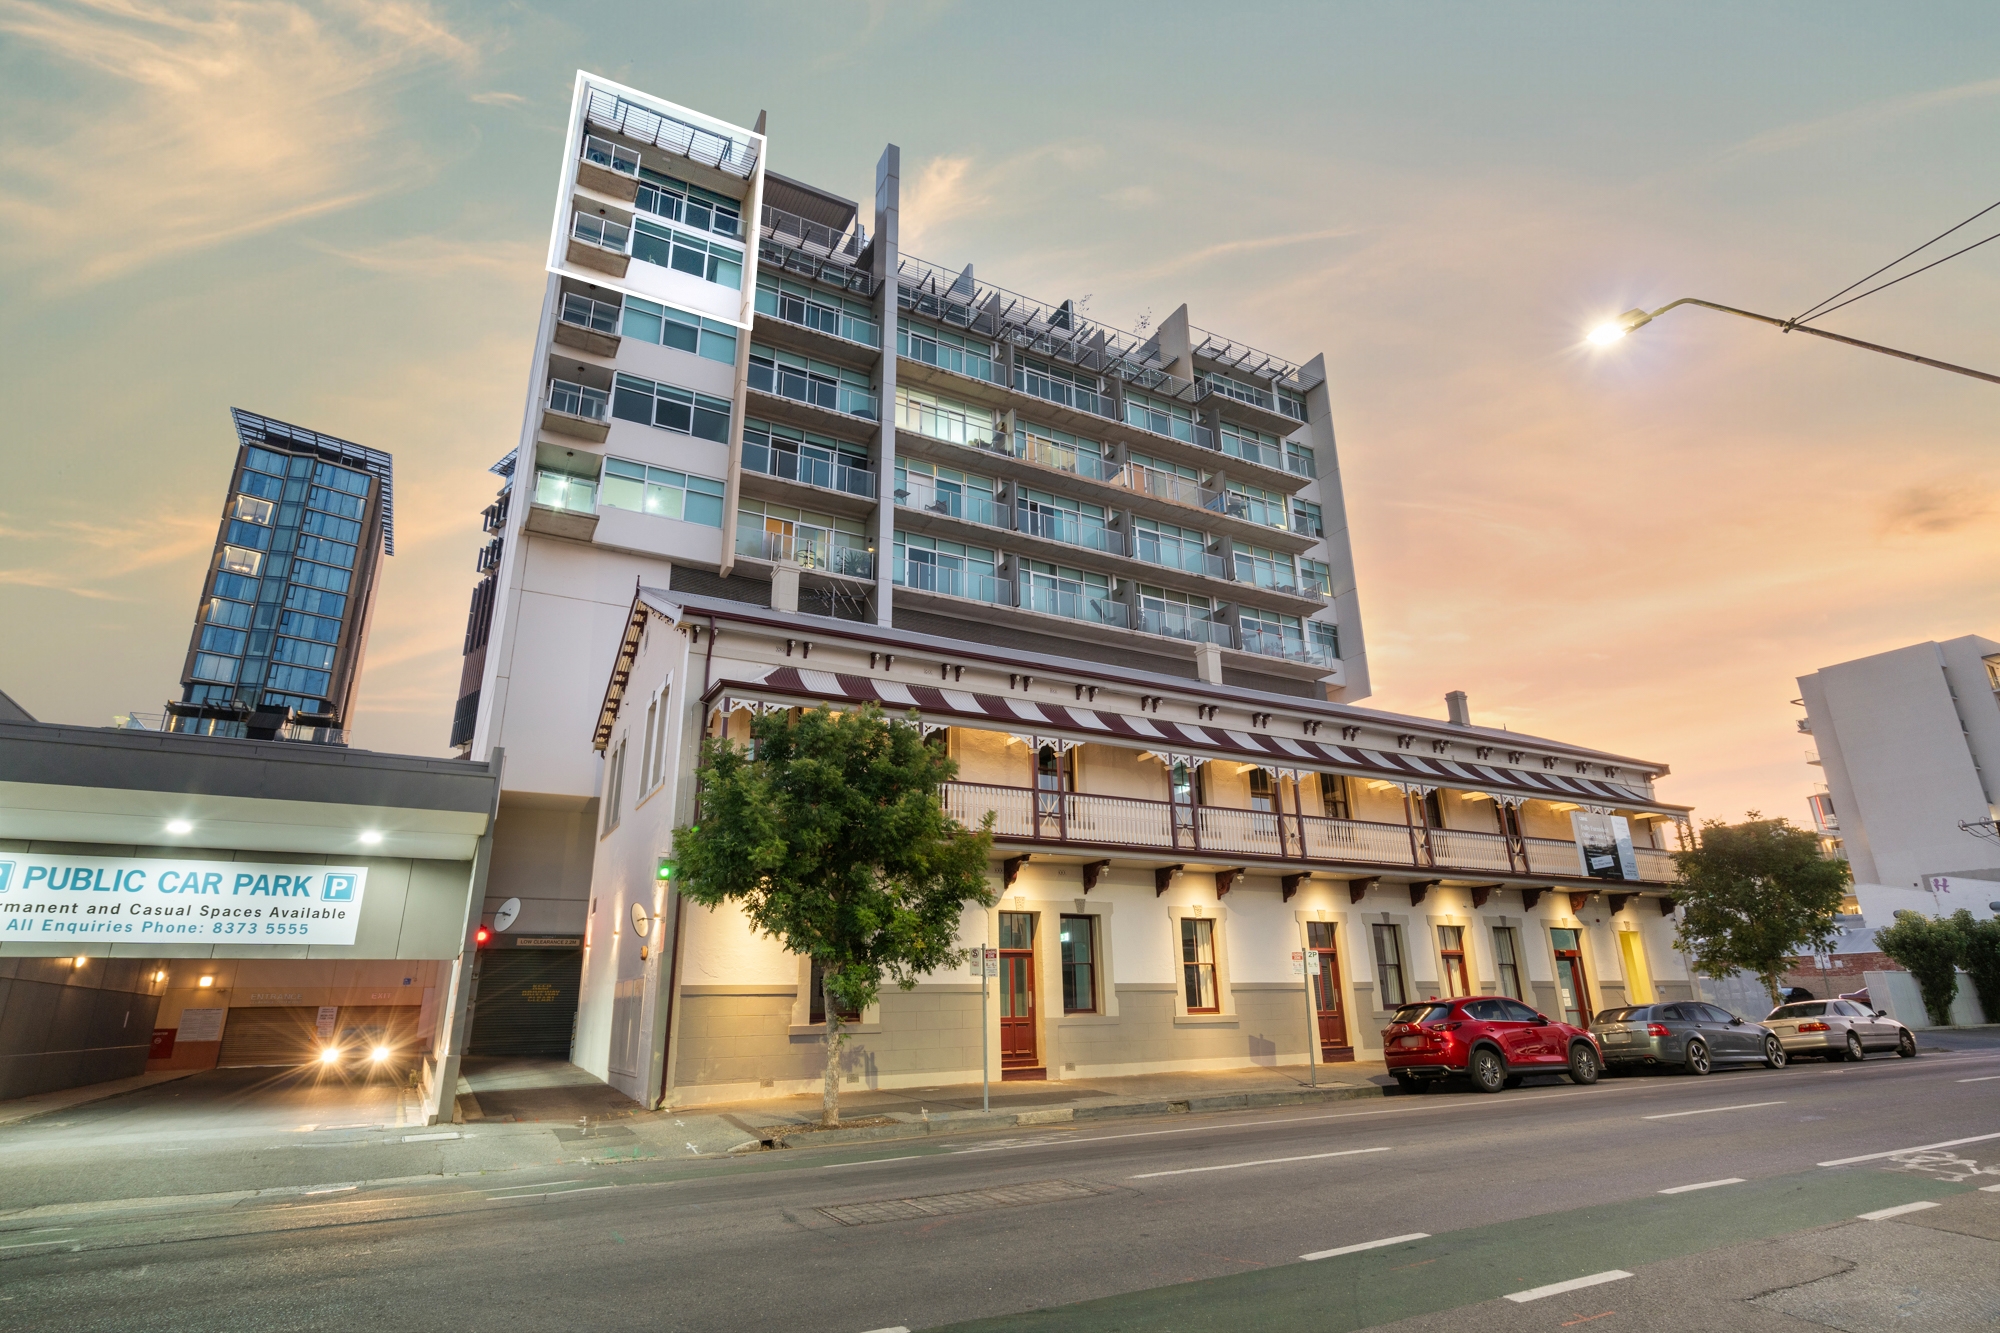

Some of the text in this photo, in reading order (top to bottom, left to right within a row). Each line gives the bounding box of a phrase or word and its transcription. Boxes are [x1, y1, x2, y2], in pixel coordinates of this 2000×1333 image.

[23, 866, 146, 892] PUBLIC
[158, 871, 223, 894] CAR
[233, 873, 313, 897] PARK
[0, 903, 346, 919] manent and Casual Spaces Available
[6, 918, 308, 935] All Enquiries Phone: 8373 5555
